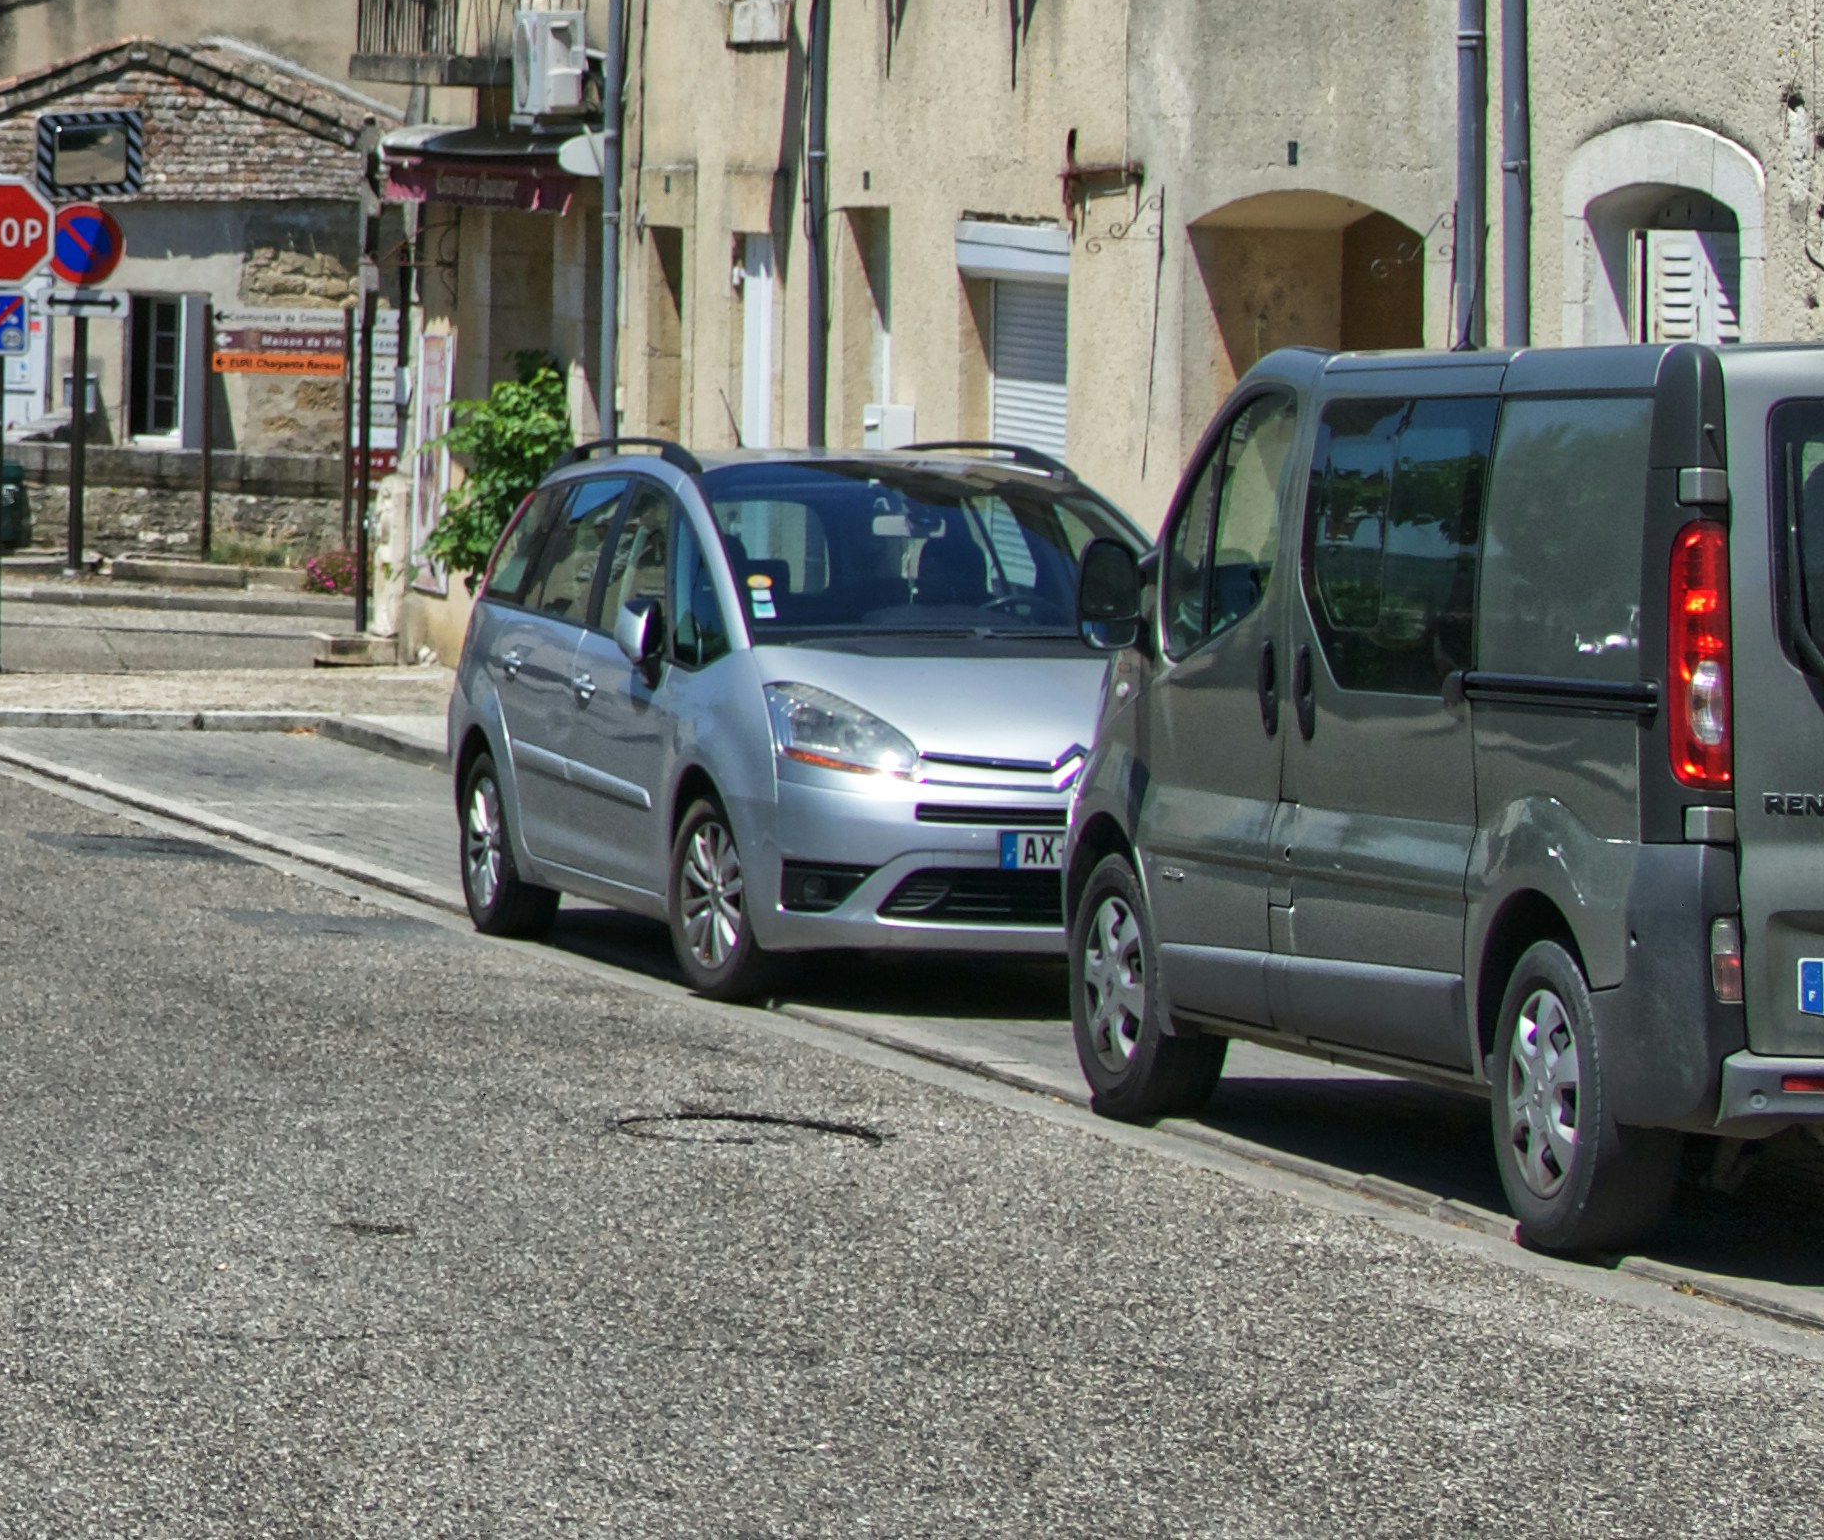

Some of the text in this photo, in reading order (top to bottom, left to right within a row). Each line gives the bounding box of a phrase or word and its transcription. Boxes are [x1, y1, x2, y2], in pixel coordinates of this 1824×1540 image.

[260, 334, 343, 348] Maison du Vin
[256, 356, 305, 371] Charpente
[1762, 792, 1824, 816] REN
[1808, 989, 1817, 1003] F
